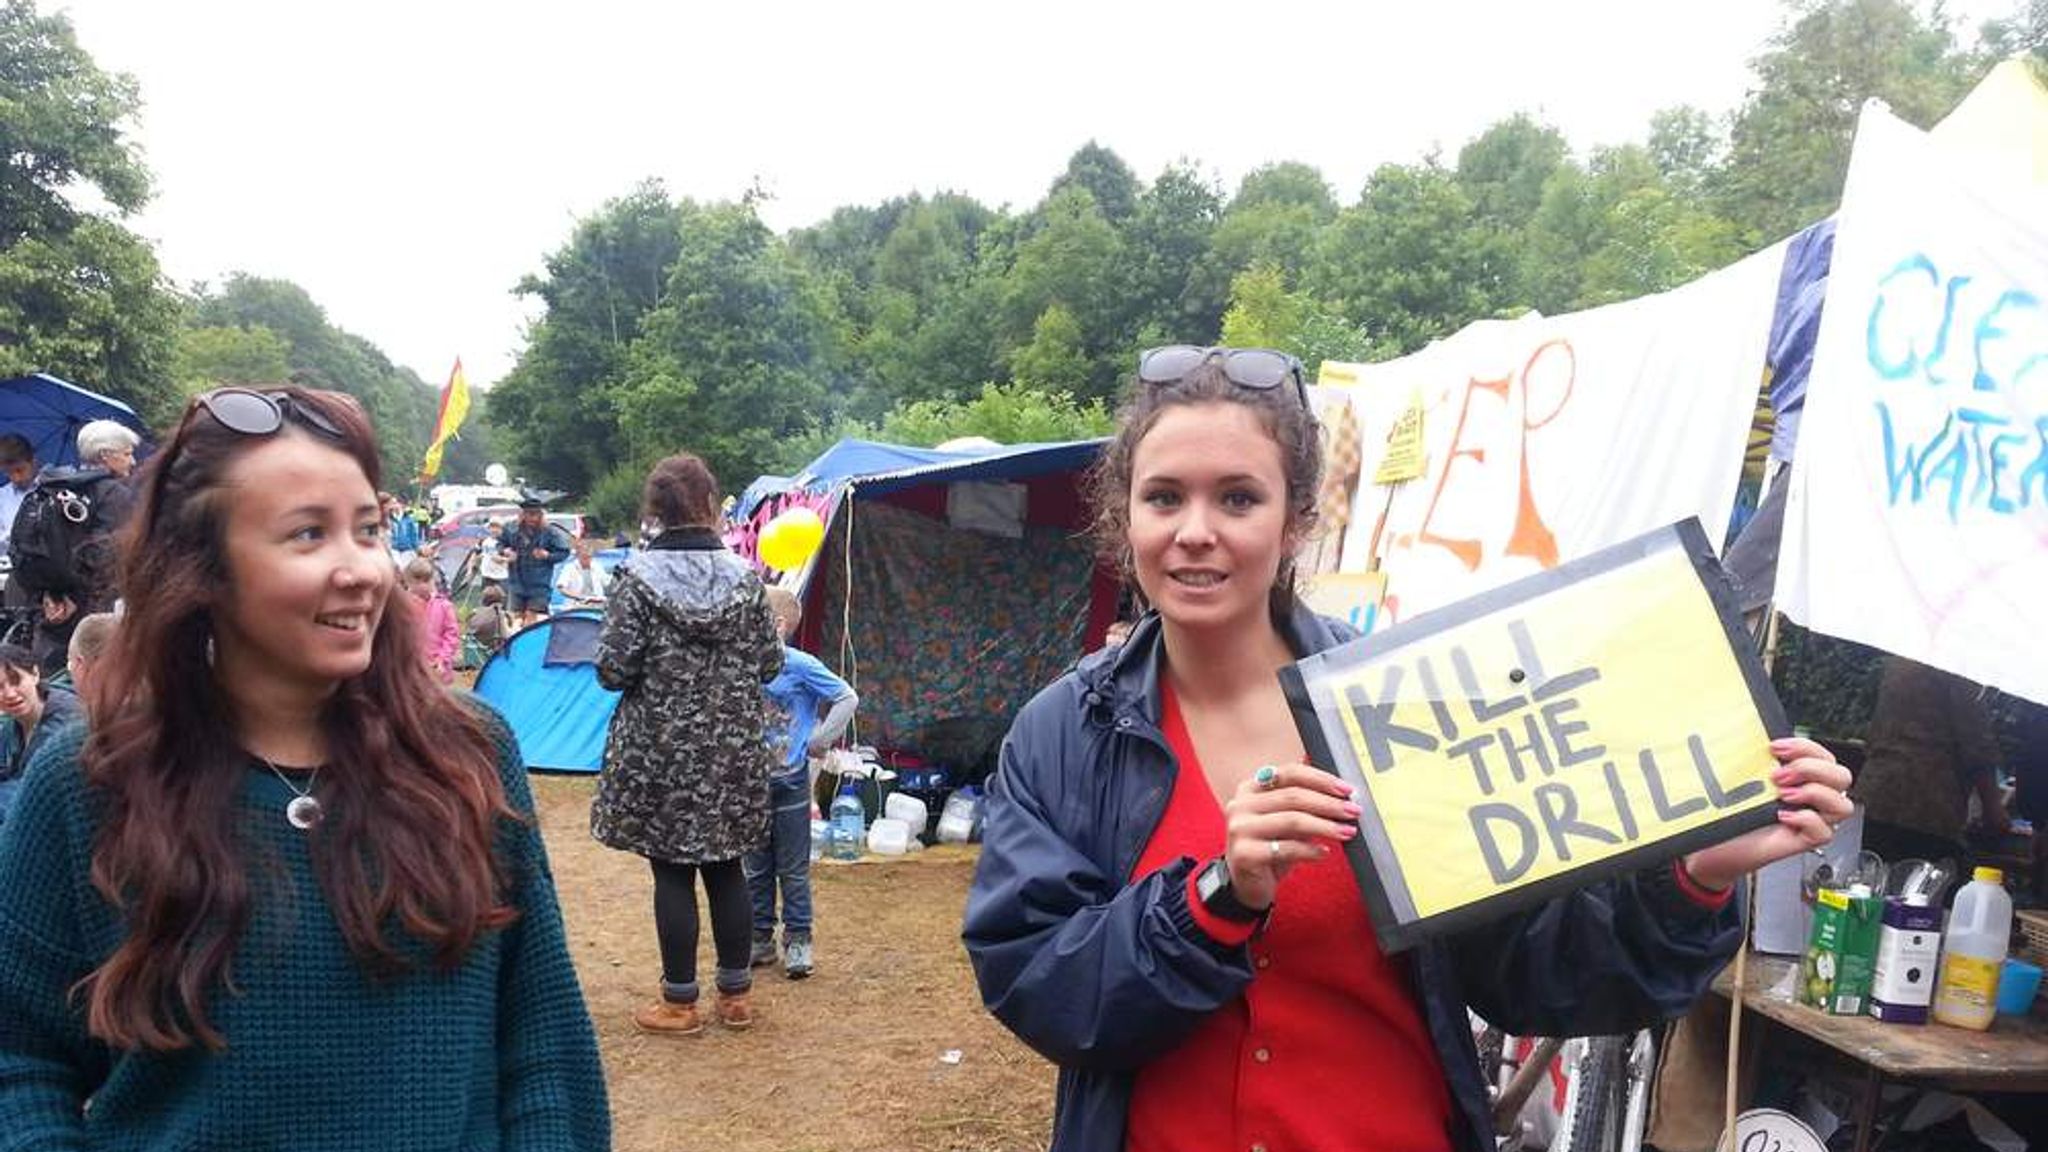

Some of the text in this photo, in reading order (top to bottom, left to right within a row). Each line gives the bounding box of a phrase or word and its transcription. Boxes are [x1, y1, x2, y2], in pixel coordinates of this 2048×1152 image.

[1345, 619, 1601, 773] KILL
[1446, 697, 1606, 796] THE
[1469, 734, 1766, 885] DRILL
